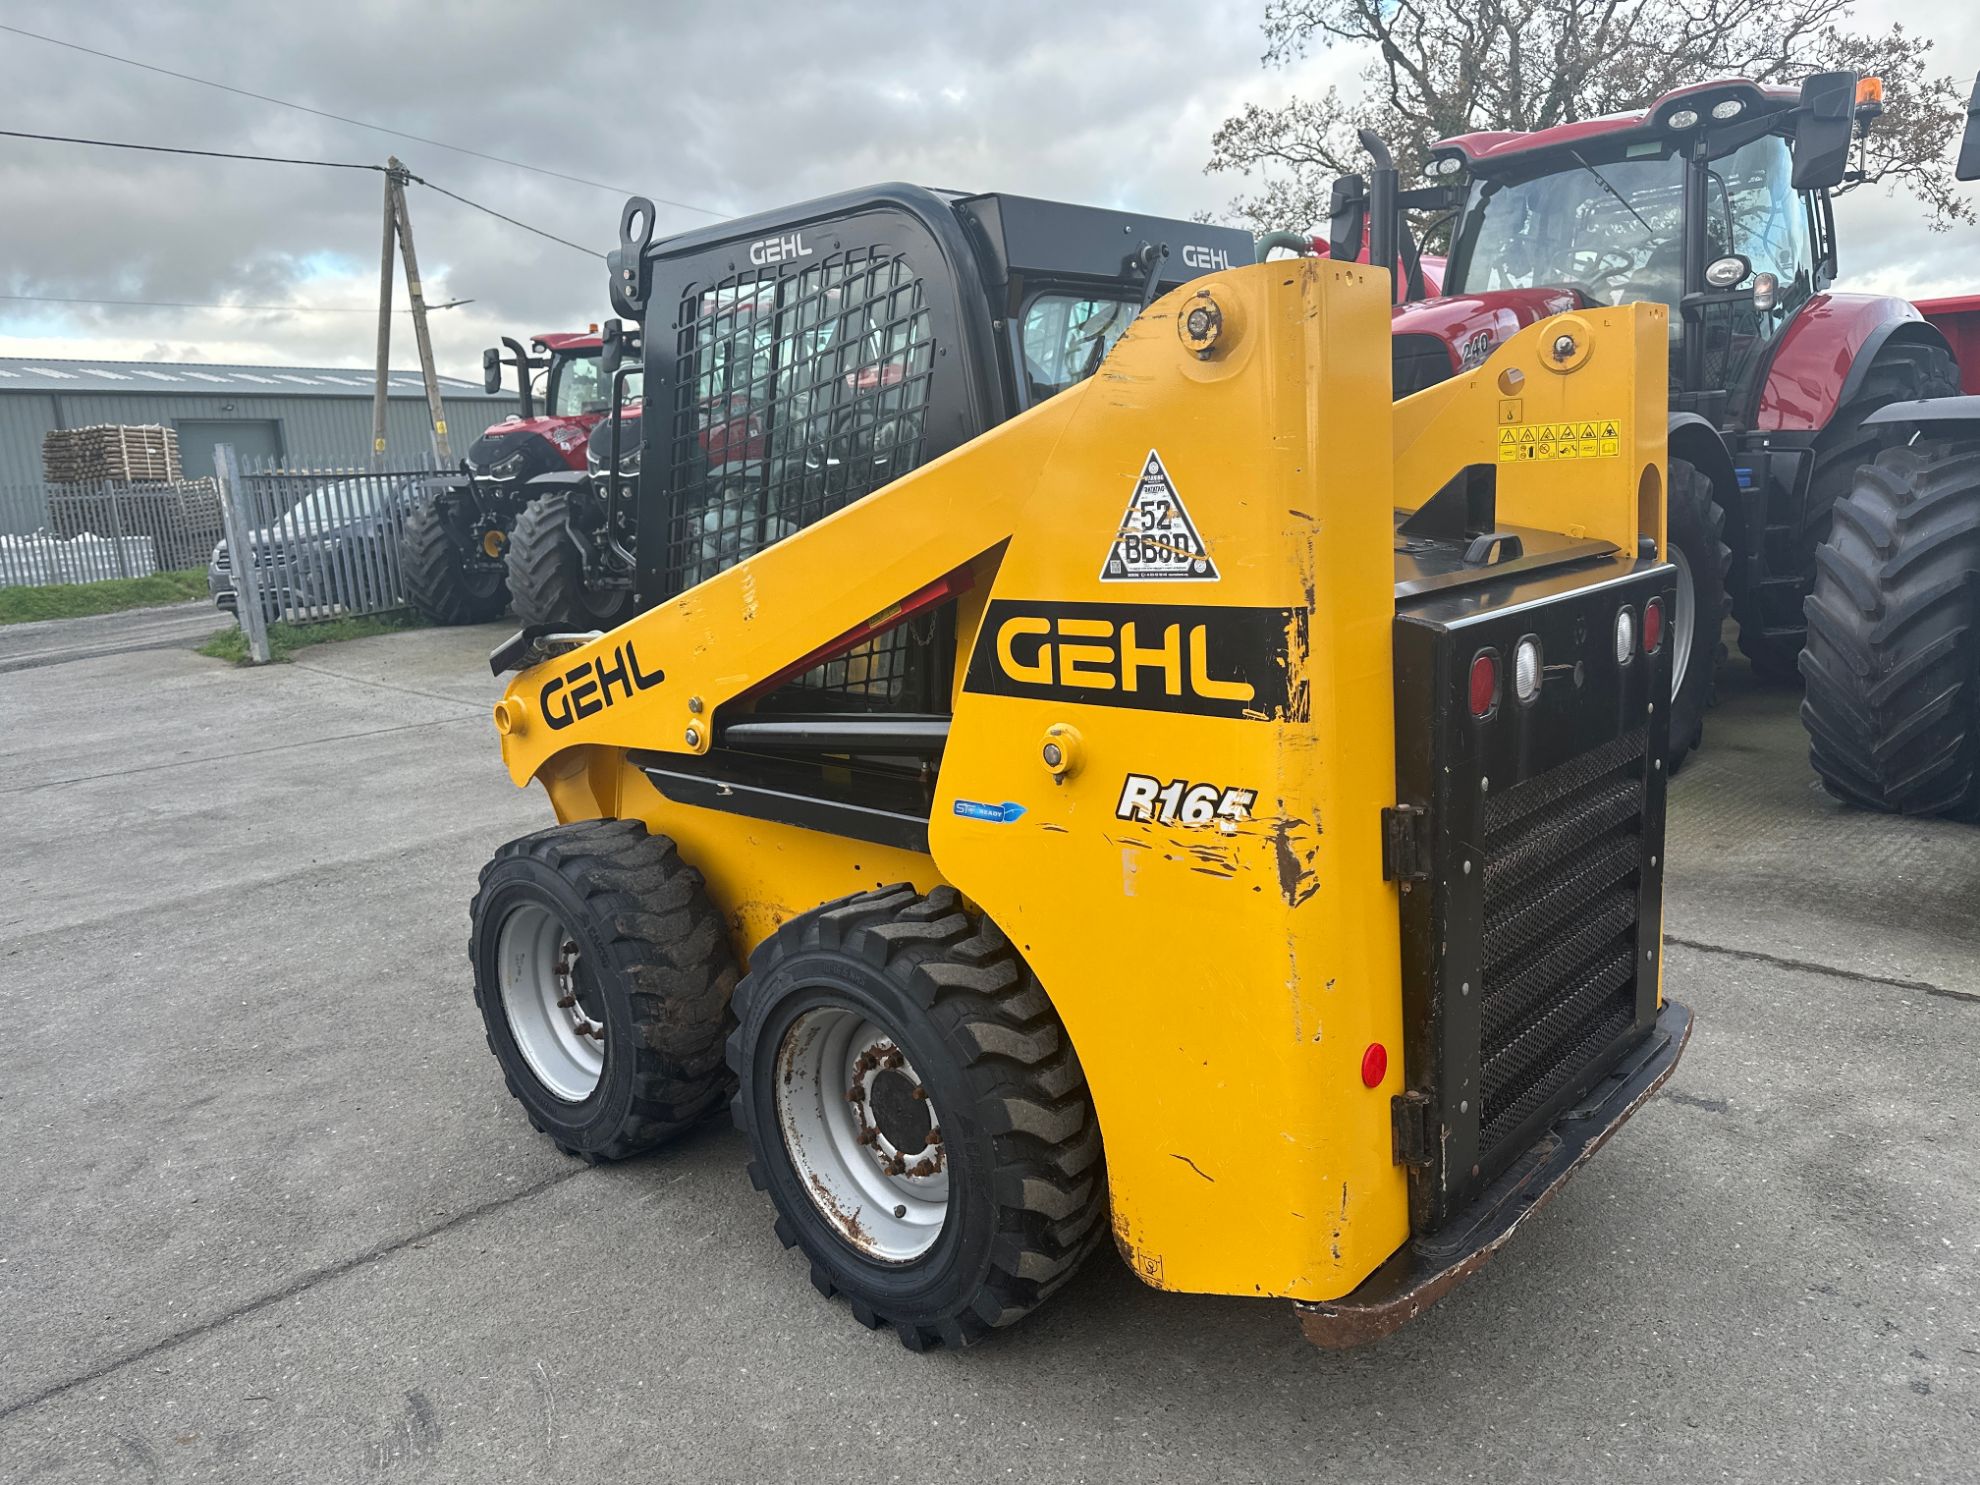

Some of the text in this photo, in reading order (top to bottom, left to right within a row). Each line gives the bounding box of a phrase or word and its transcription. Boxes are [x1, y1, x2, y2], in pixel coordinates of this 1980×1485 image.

[749, 233, 813, 265] GEHL
[1182, 245, 1237, 270] GEHL
[1462, 332, 1488, 364] 240
[1141, 500, 1172, 531] 52
[996, 617, 1255, 702] GEHL
[540, 640, 665, 731] GEHL
[1115, 772, 1259, 838] R165
